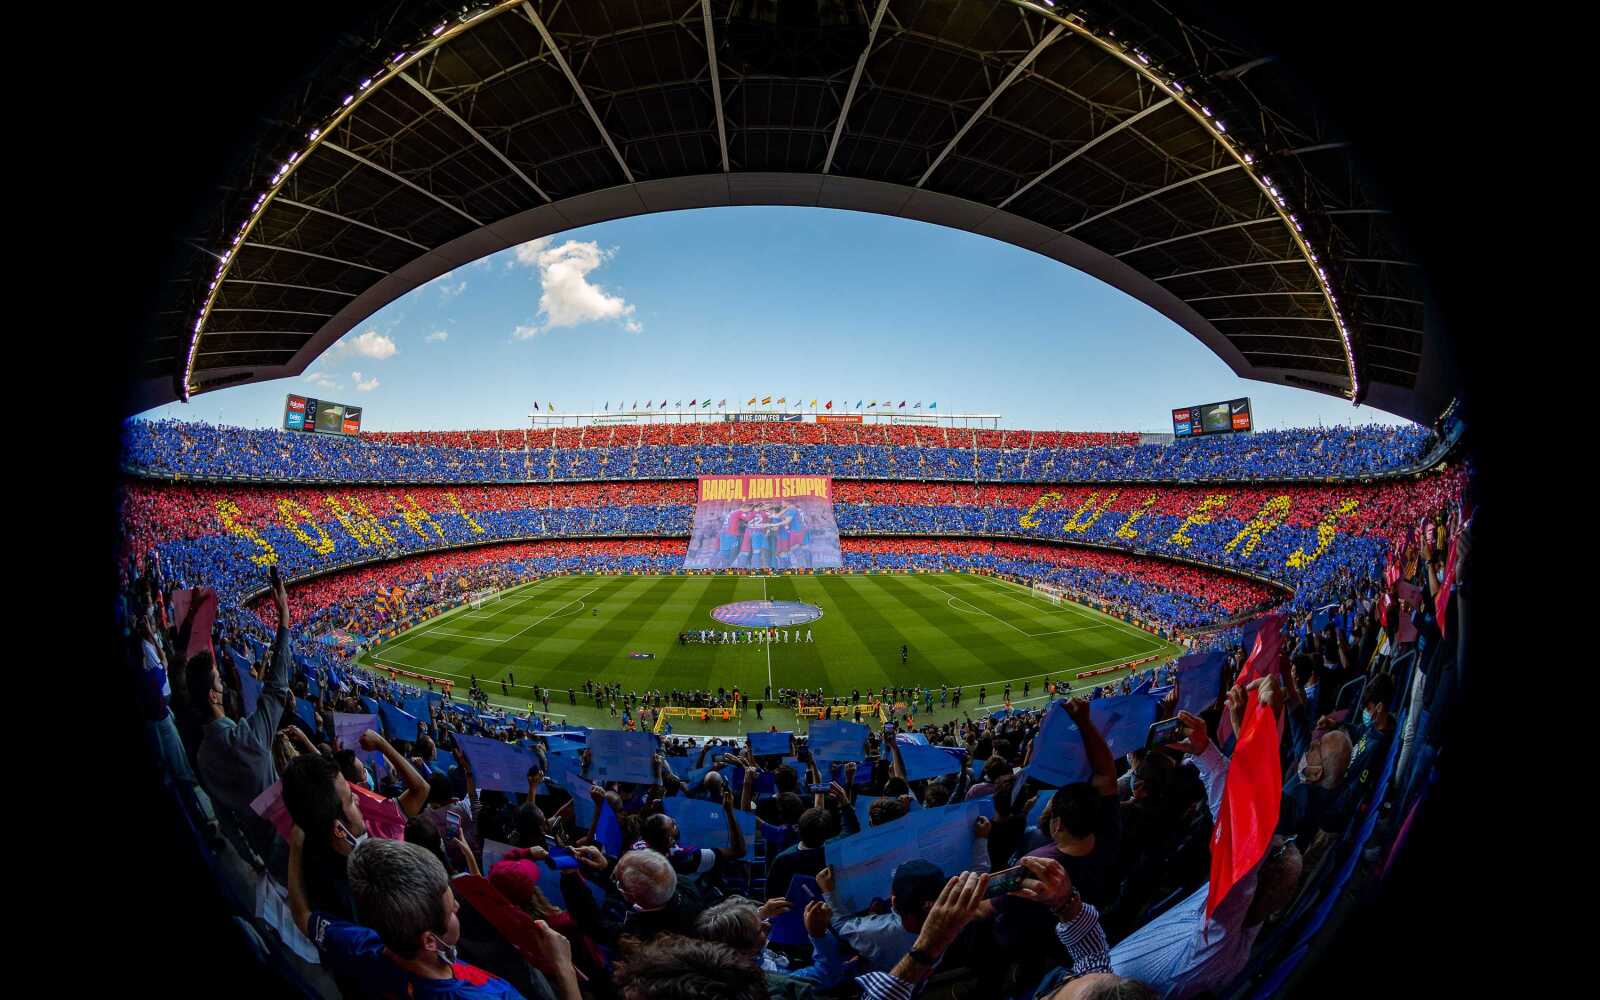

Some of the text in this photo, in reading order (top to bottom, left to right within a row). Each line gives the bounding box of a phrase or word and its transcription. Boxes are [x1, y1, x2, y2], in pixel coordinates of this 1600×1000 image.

[748, 479, 773, 499] ARA
[774, 478, 781, 498] I
[782, 478, 828, 498] SEMPRE
